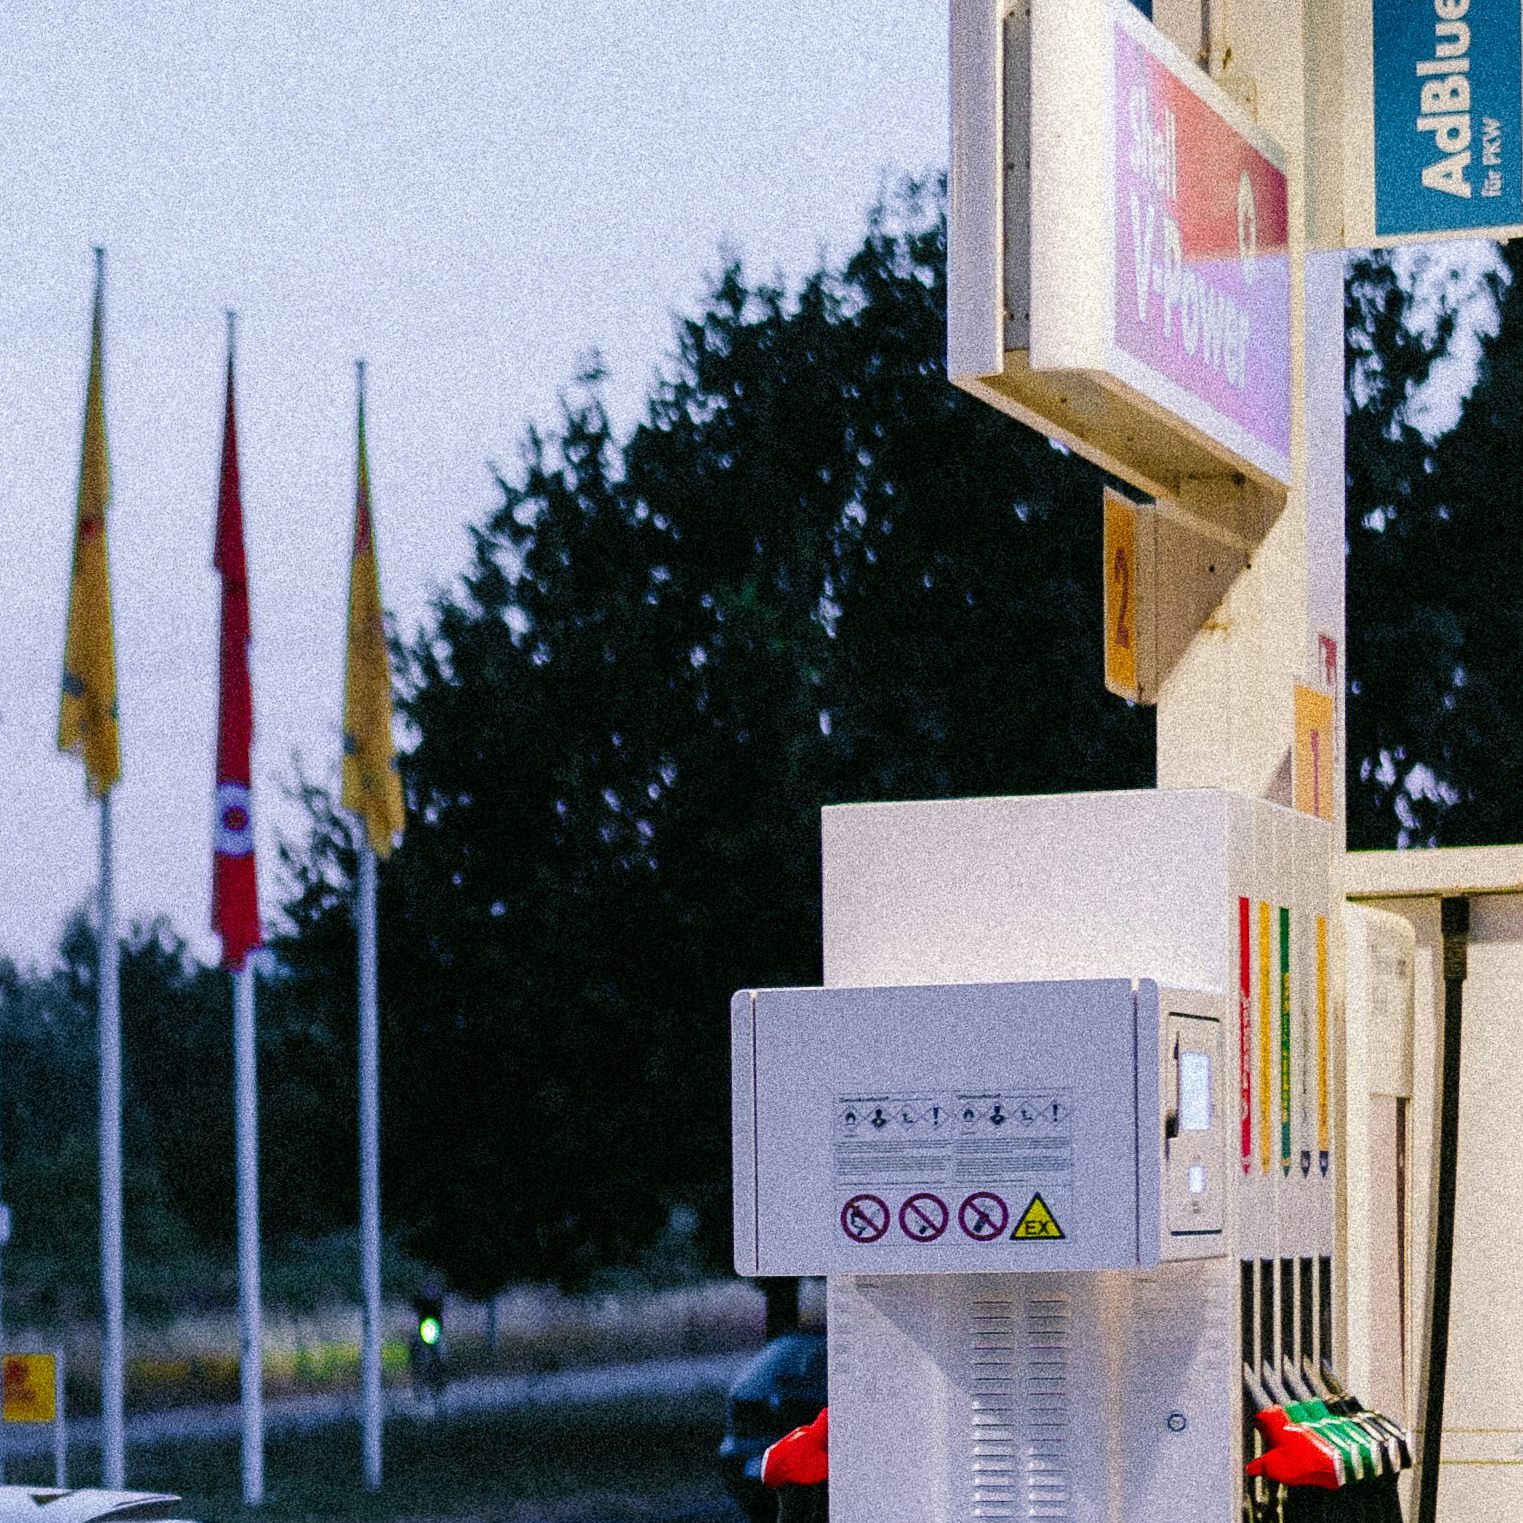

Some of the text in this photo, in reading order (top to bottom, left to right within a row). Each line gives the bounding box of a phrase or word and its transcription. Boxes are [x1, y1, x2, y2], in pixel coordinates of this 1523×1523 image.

[1128, 80, 1178, 201] Shell
[1481, 117, 1502, 165] PKW
[1128, 184, 1252, 393] V-Power
[1024, 1219, 1051, 1236] EX
